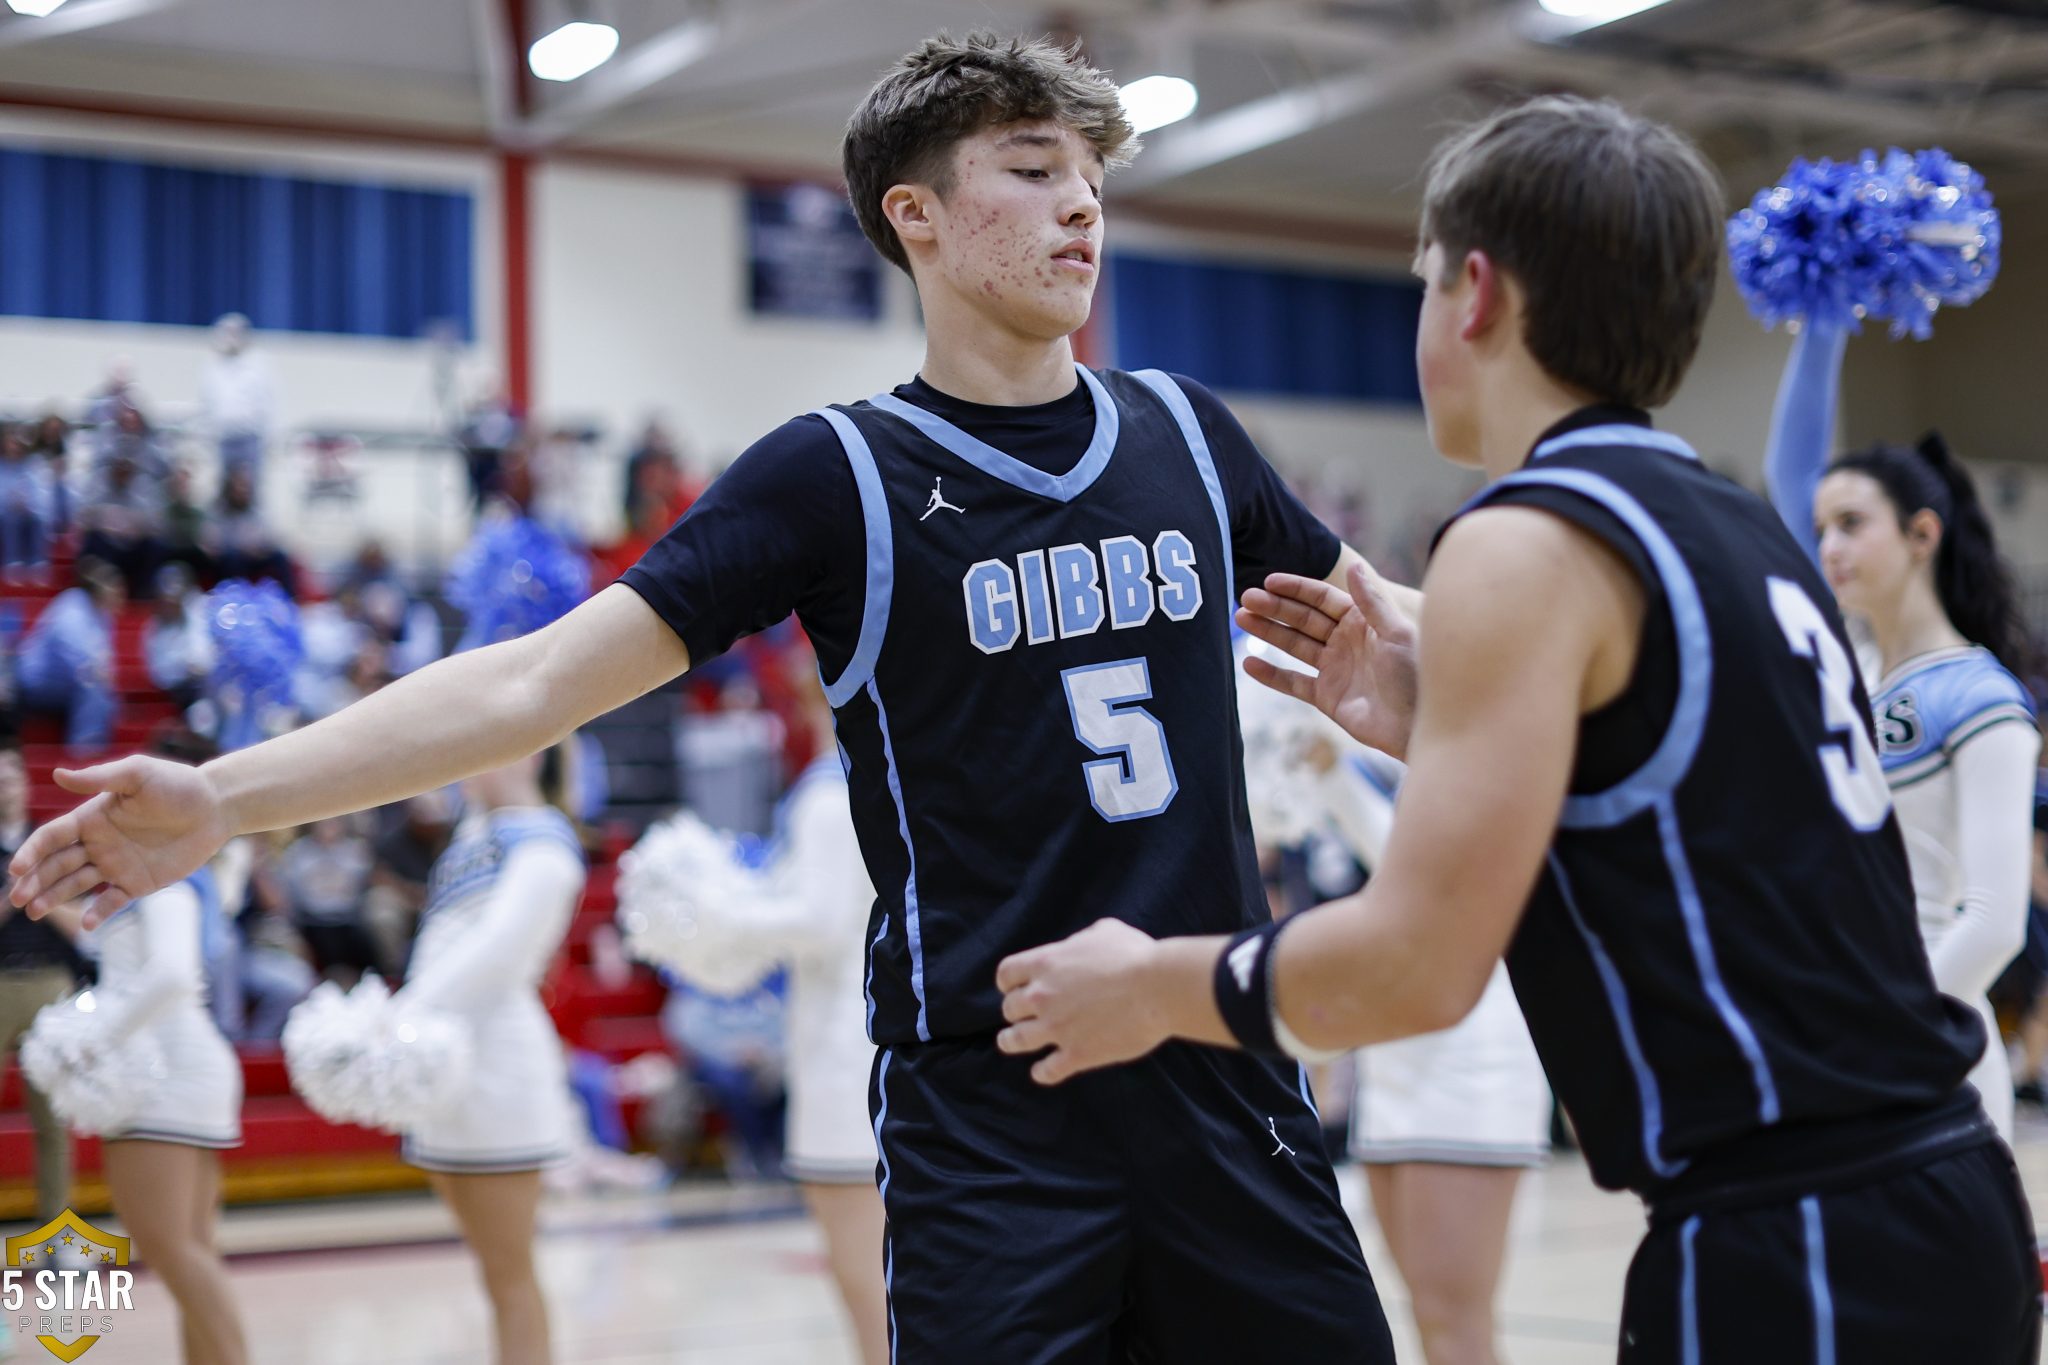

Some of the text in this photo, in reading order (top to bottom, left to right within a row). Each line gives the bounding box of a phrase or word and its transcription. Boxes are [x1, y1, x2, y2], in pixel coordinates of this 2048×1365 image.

[962, 529, 1203, 655] GIBBS
[1059, 656, 1179, 823] 5
[1765, 575, 1893, 832] 3
